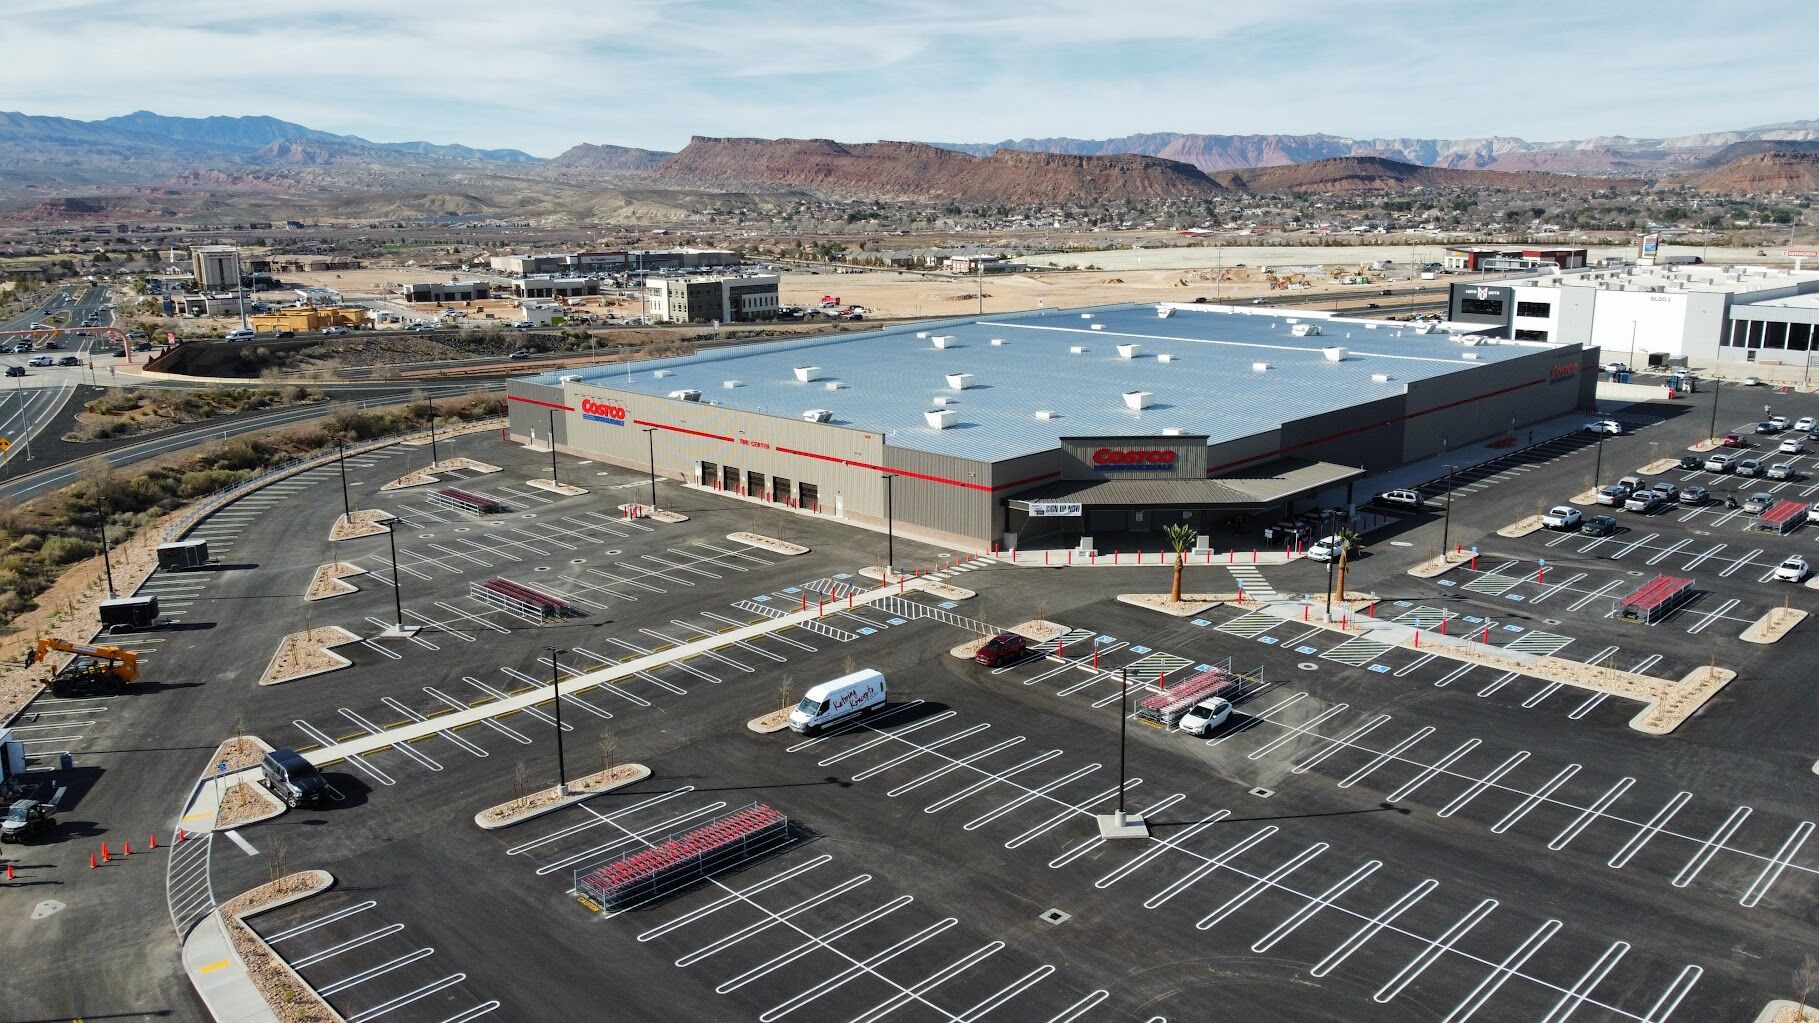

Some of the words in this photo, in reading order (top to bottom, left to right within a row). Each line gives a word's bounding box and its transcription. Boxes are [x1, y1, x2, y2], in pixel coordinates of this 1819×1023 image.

[582, 399, 625, 420] COSTCO
[1093, 447, 1177, 465] COSTCO
[1045, 504, 1058, 513] SIGN
[1059, 504, 1067, 513] UP
[1068, 504, 1081, 513] NOW
